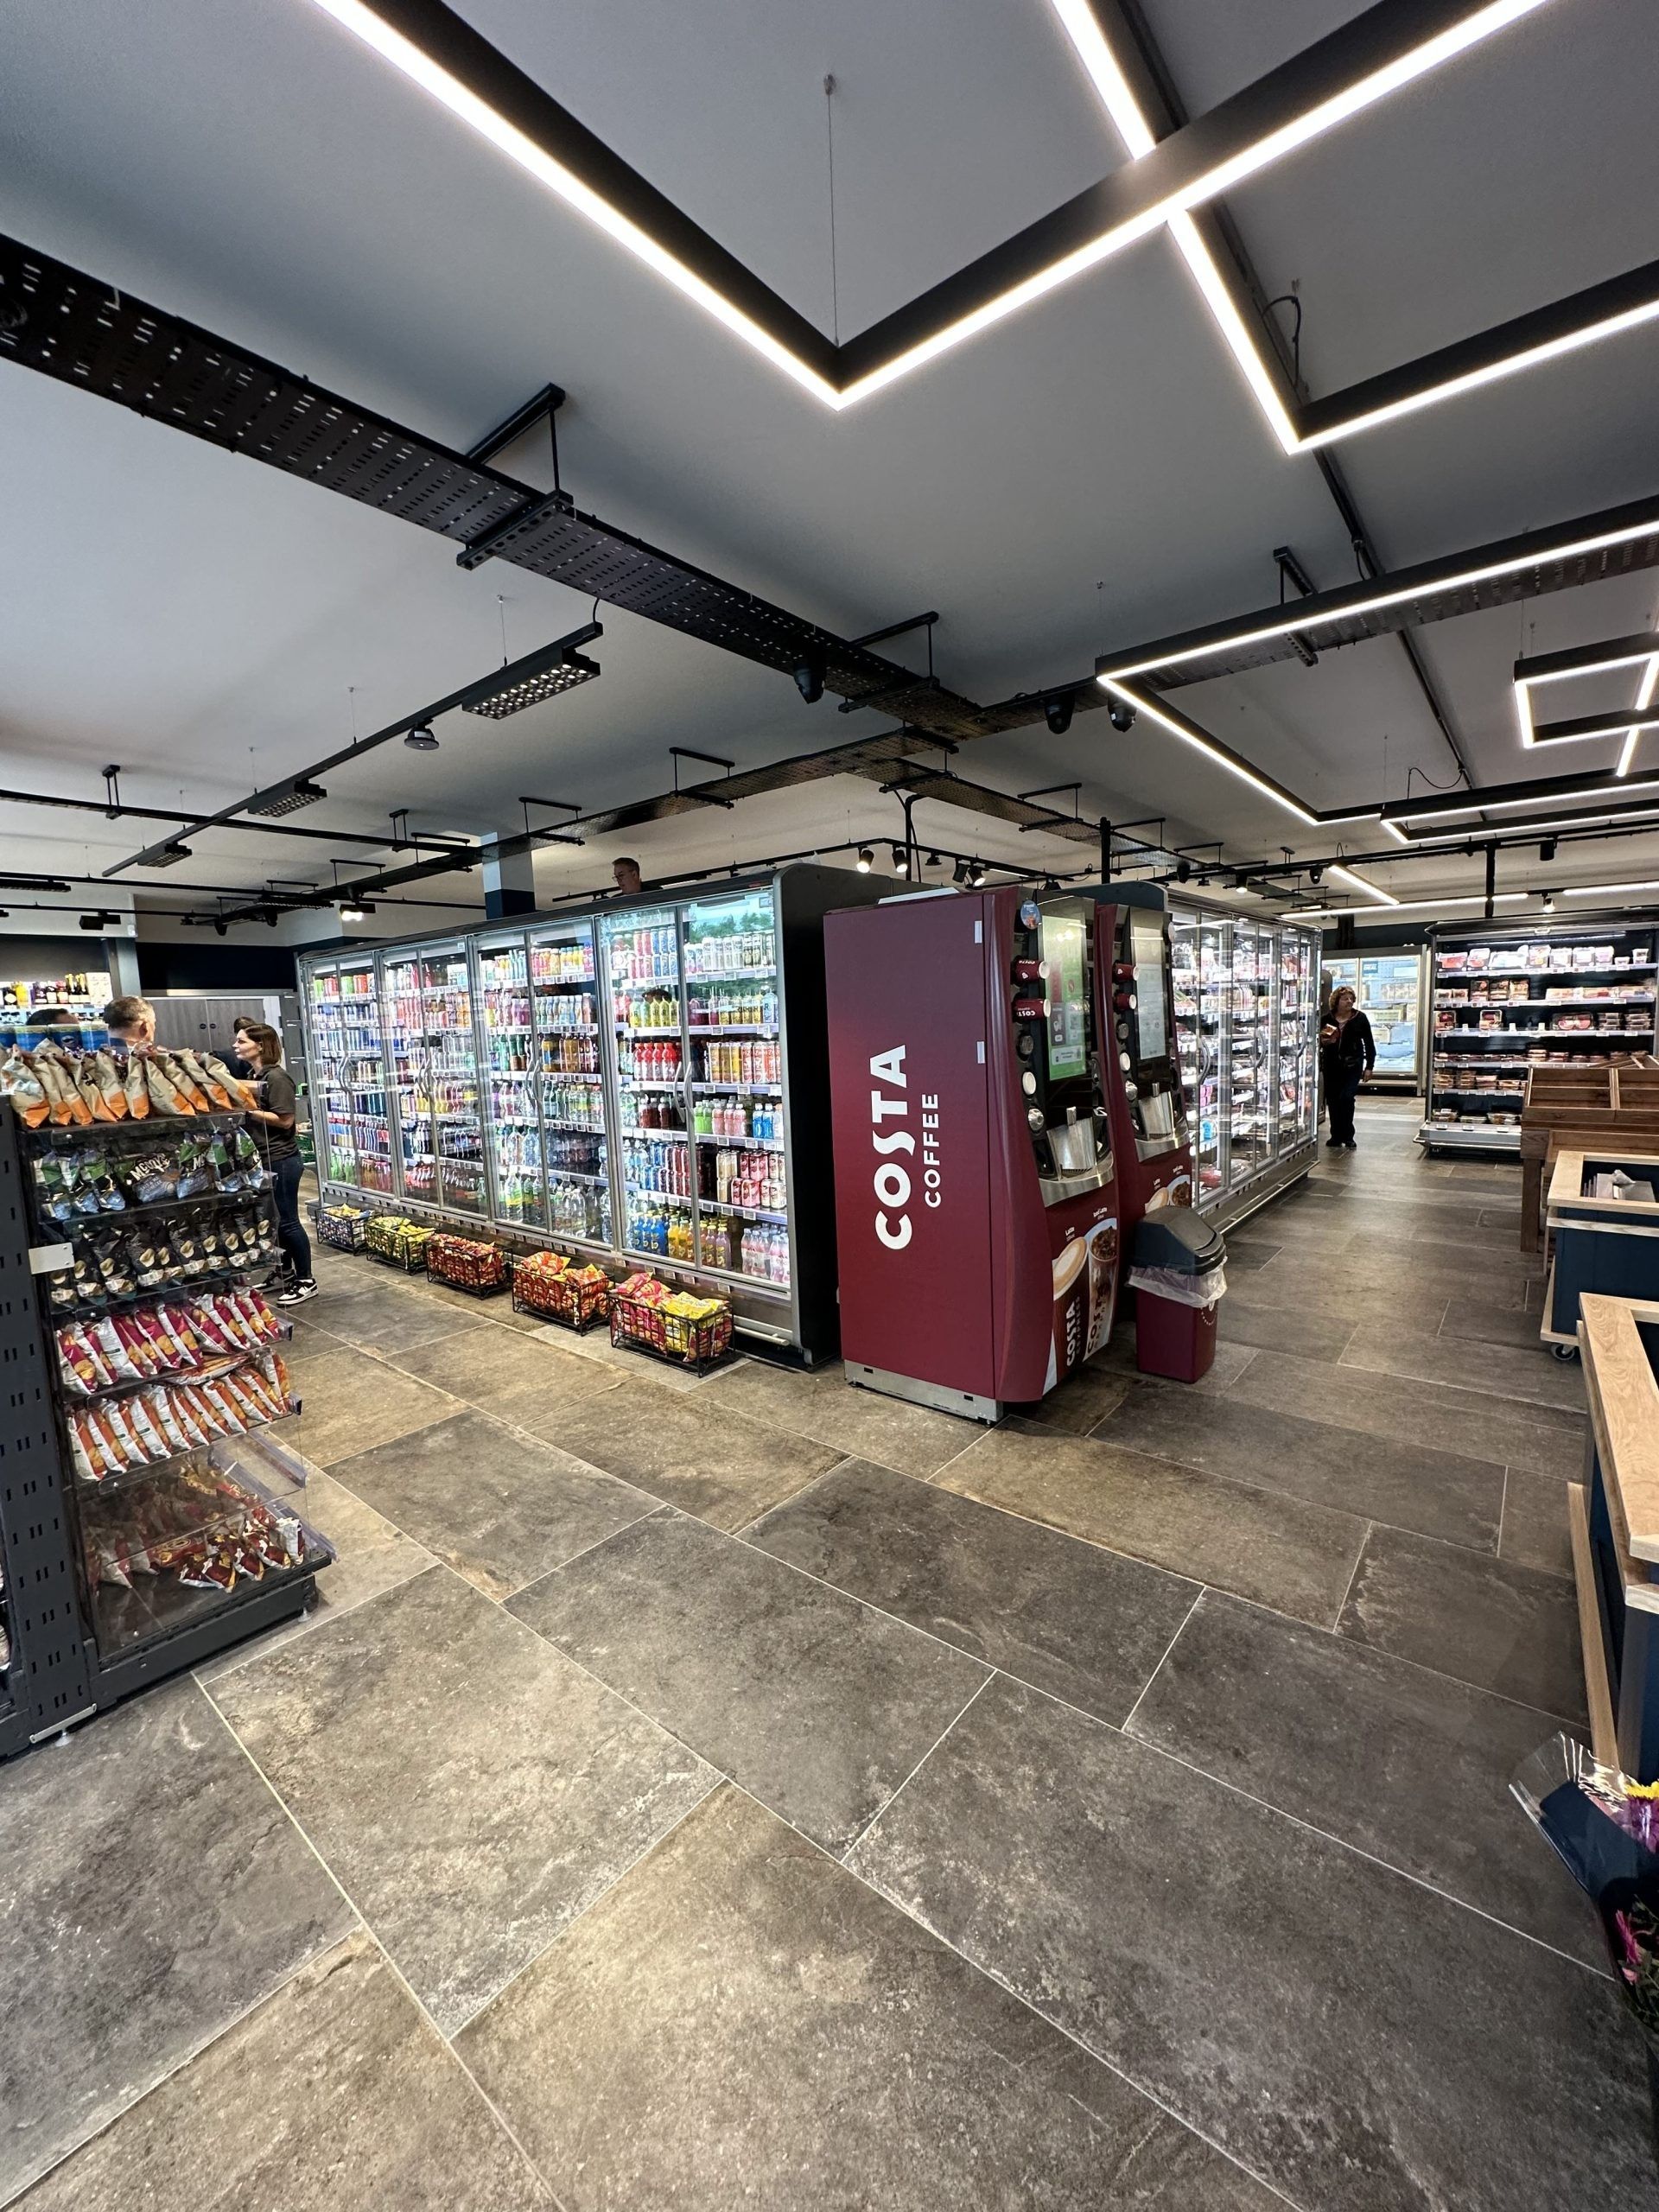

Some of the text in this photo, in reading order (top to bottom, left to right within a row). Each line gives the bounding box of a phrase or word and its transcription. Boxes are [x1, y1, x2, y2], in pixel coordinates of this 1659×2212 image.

[869, 1044, 916, 1250] COSTA
[921, 1093, 942, 1208] COFFEE
[1065, 1300, 1077, 1367] COSTA
